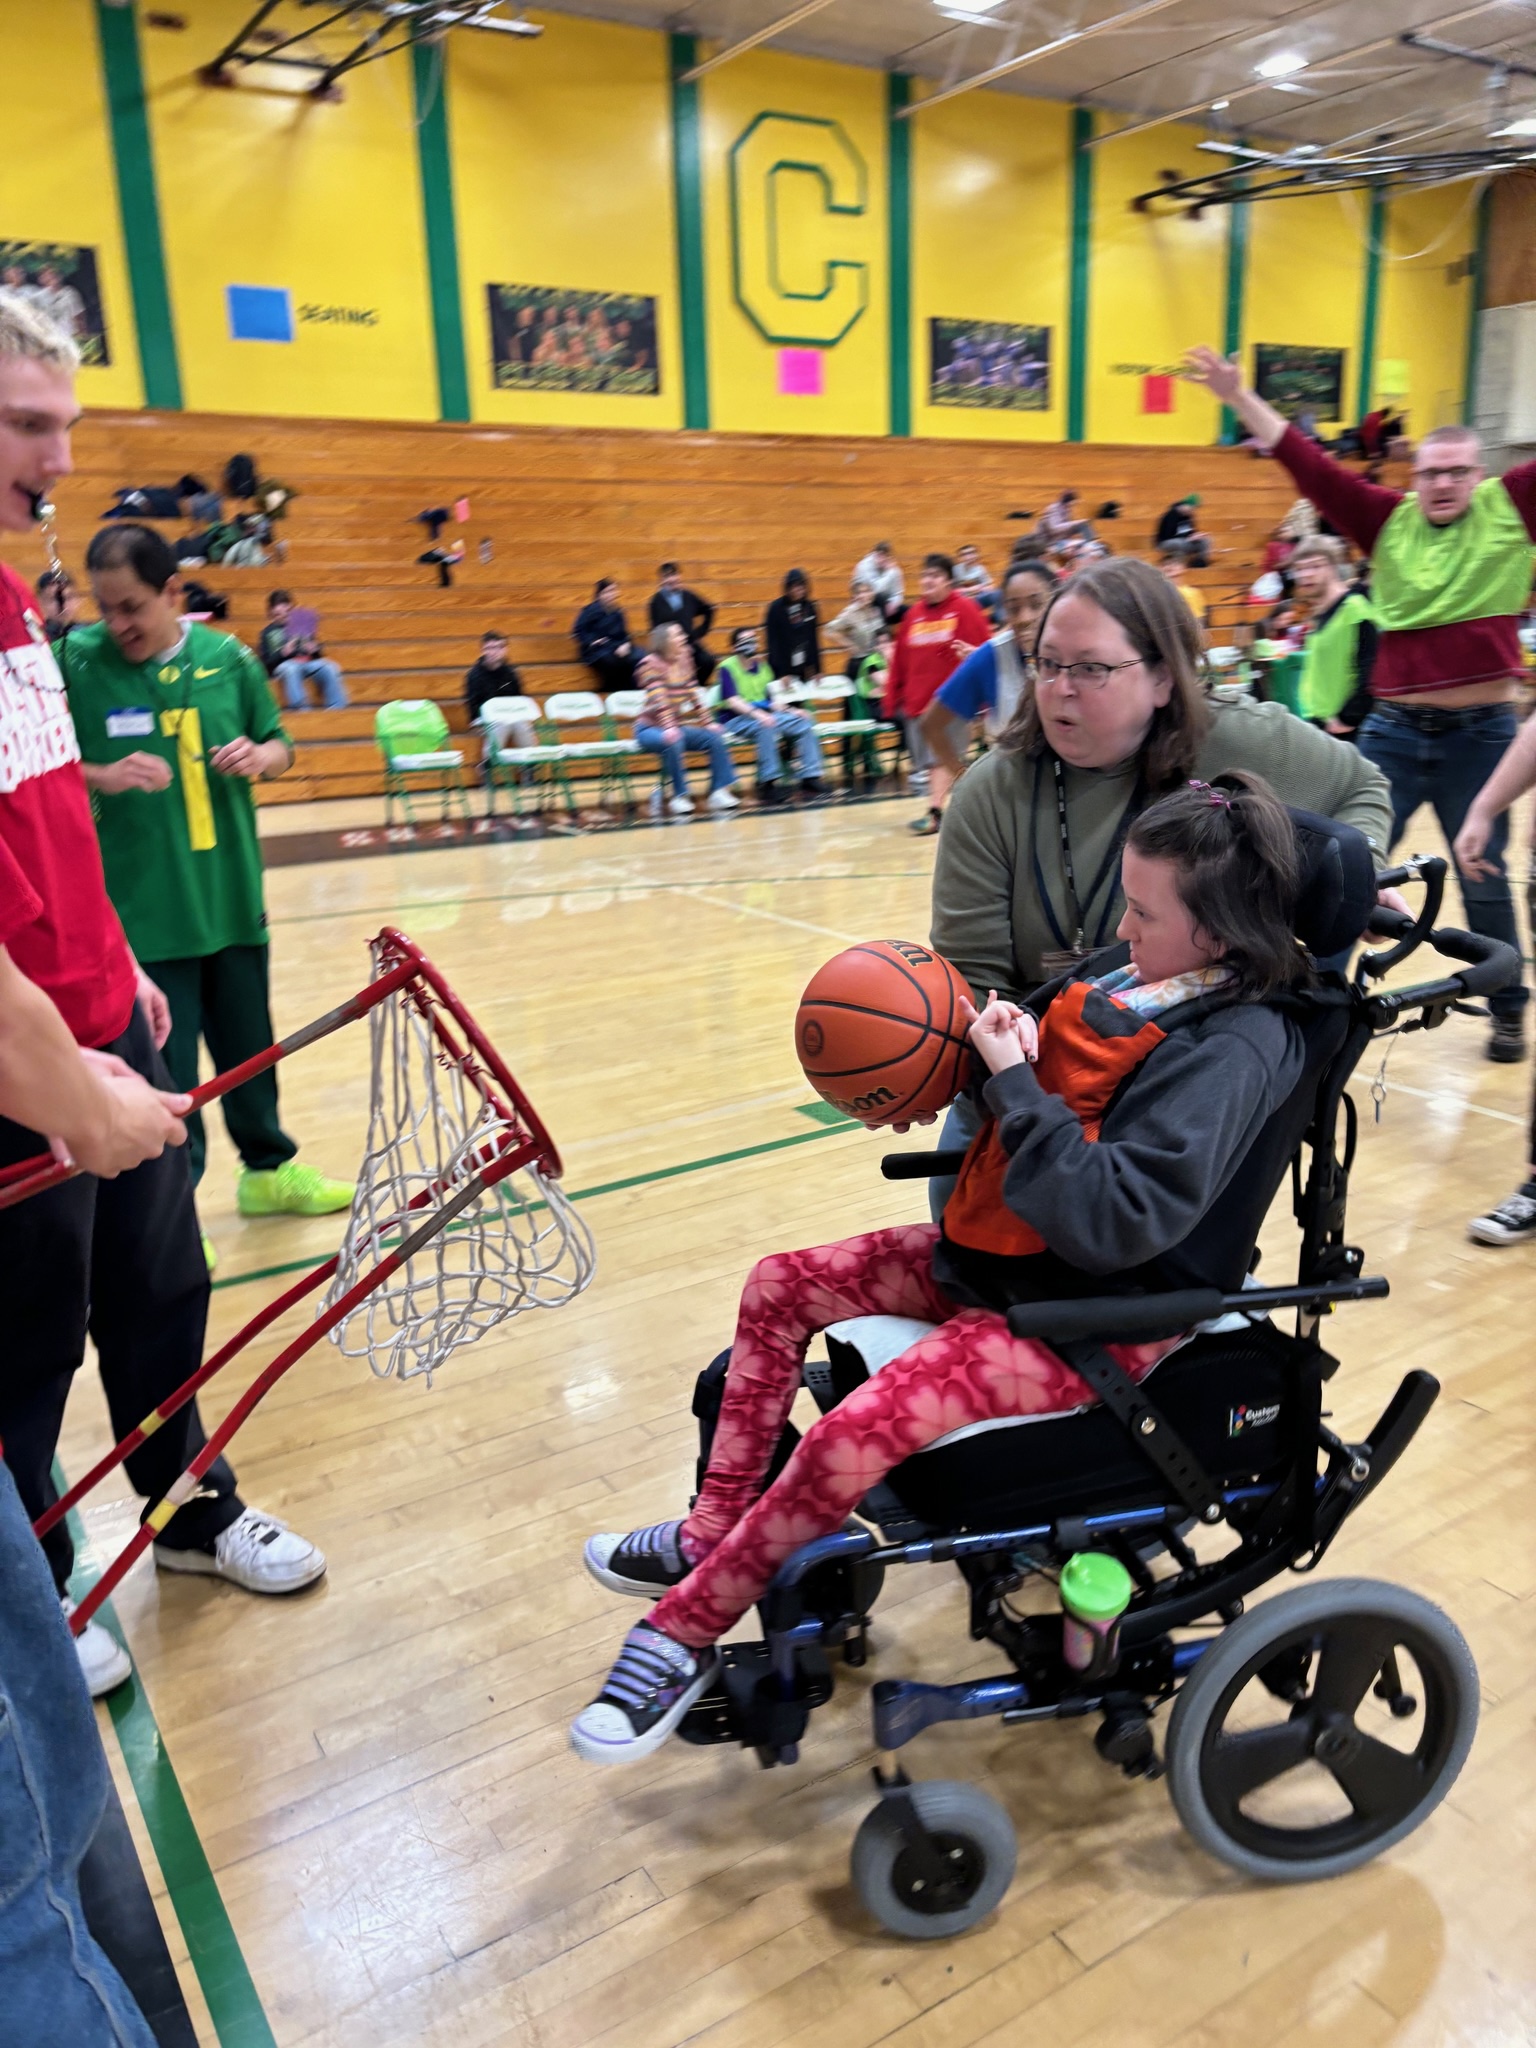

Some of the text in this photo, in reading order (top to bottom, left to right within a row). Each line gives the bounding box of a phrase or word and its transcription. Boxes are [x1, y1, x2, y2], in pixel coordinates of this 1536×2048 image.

[728, 109, 868, 347] C
[297, 303, 379, 327] SEATING
[160, 707, 217, 851] 1
